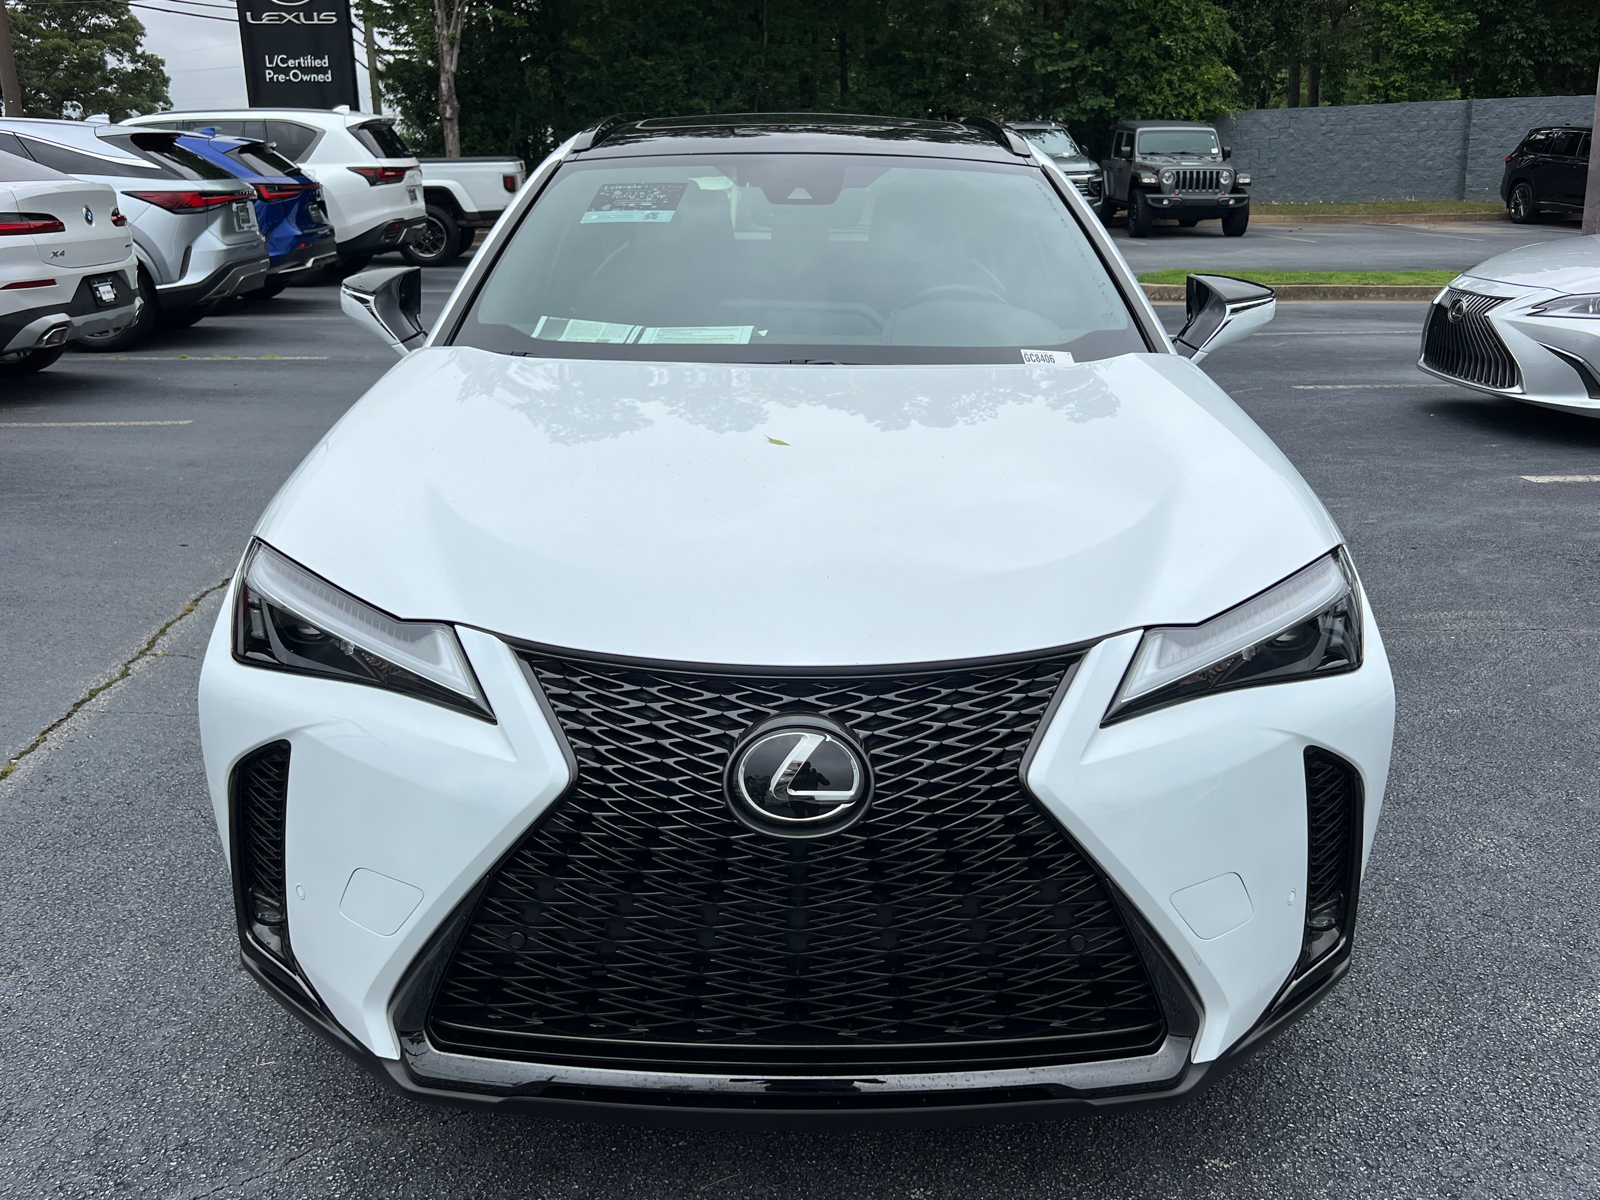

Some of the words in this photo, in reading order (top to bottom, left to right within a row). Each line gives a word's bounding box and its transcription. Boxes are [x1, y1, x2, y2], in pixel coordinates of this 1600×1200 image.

[246, 12, 338, 24] LEXUS
[265, 55, 329, 67] L/Certified
[265, 69, 332, 82] Pre-Owned
[50, 249, 66, 259] X4
[1024, 354, 1055, 363] GC8406
